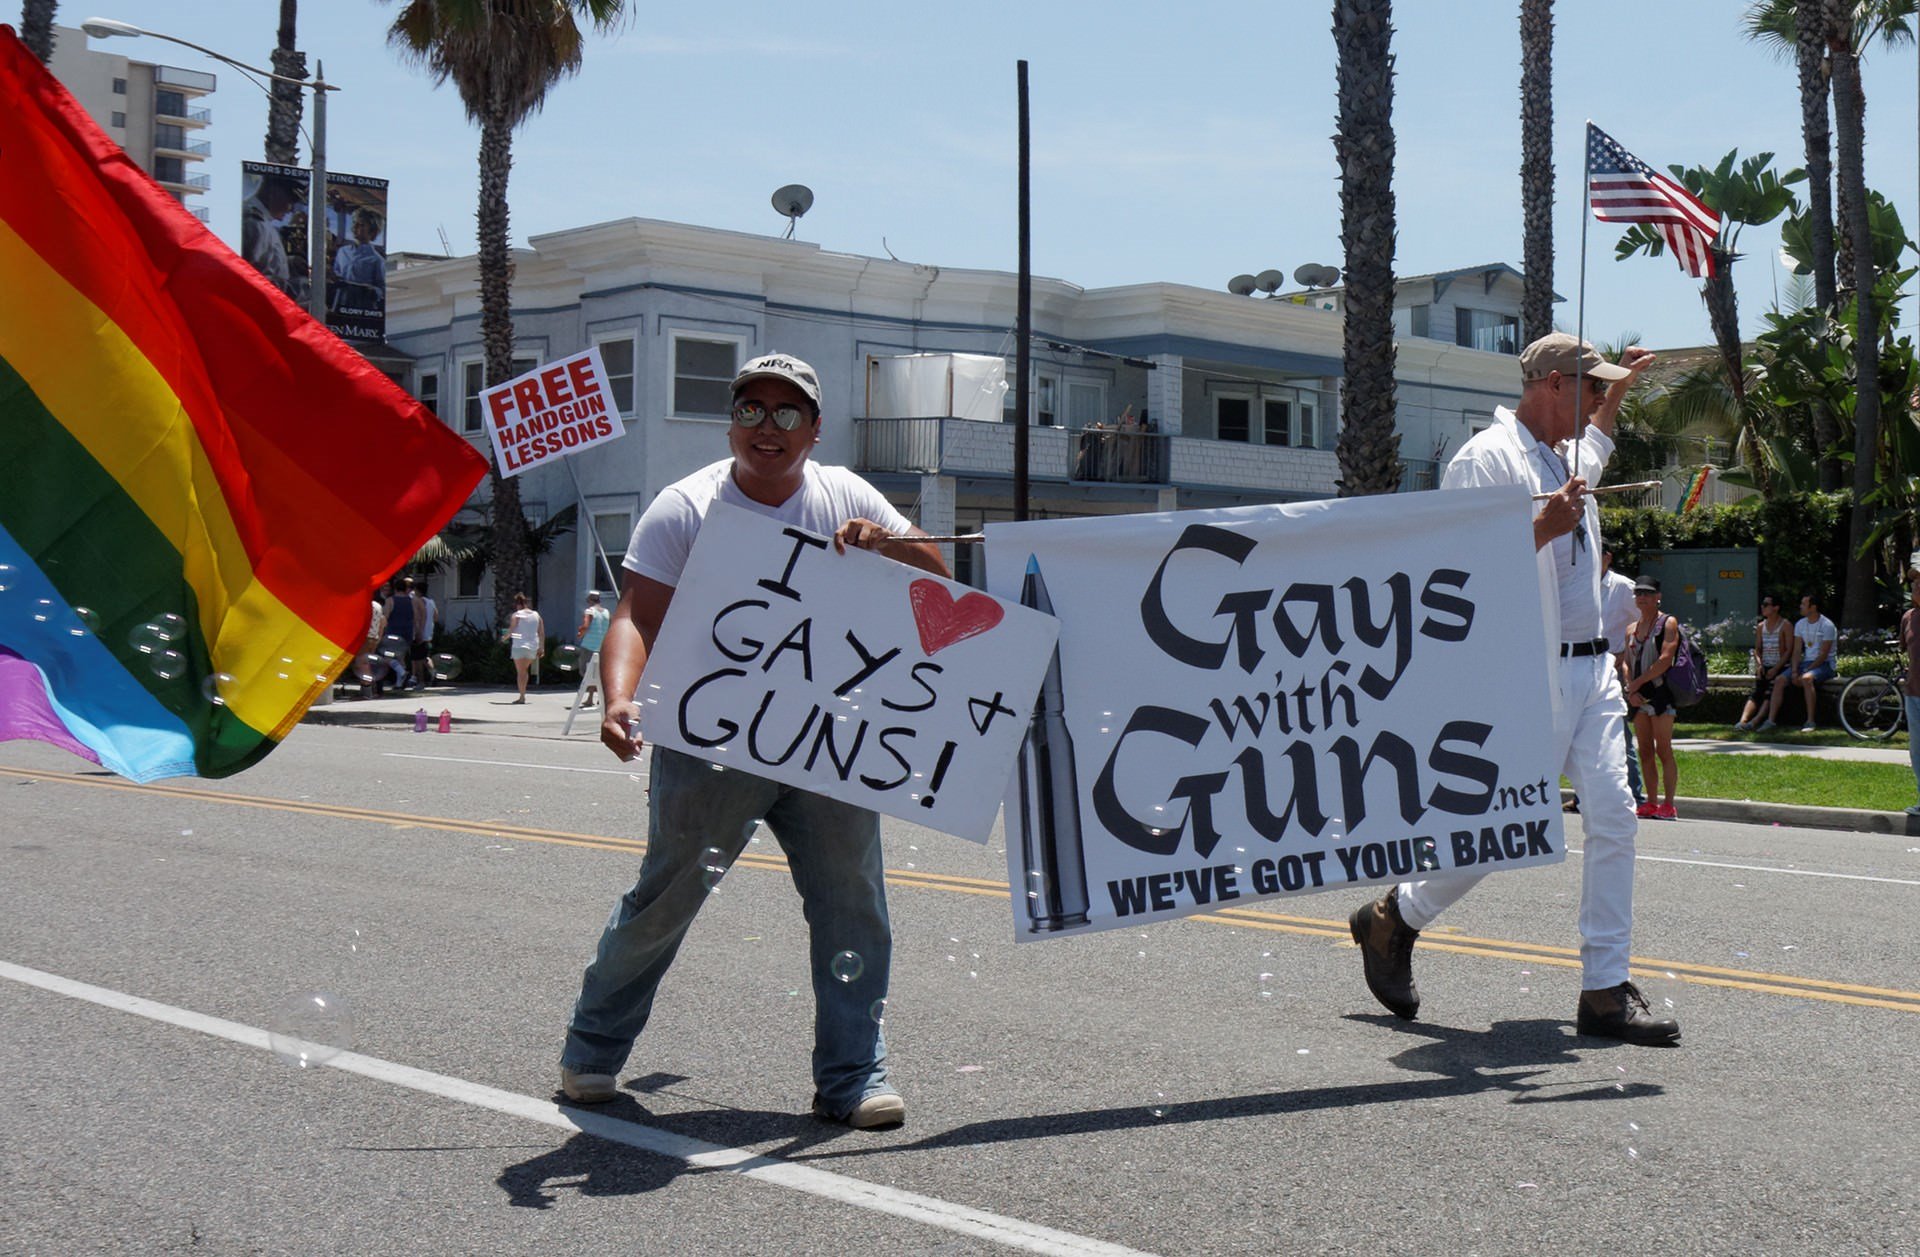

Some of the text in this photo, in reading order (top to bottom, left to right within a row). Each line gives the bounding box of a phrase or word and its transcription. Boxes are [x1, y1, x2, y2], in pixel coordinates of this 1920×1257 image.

[246, 163, 280, 174] TOURS
[487, 356, 601, 429] FREE
[757, 359, 793, 371] NRA
[498, 393, 606, 449] HANDGUN
[504, 415, 613, 471] LESSONS
[757, 527, 829, 603] I
[1140, 523, 1476, 702] Gays
[711, 600, 944, 713] GAYS
[678, 667, 959, 809] GUNS!
[1208, 659, 1361, 743] with
[1107, 819, 1553, 918] WE'VE GOT YOUR BACK
